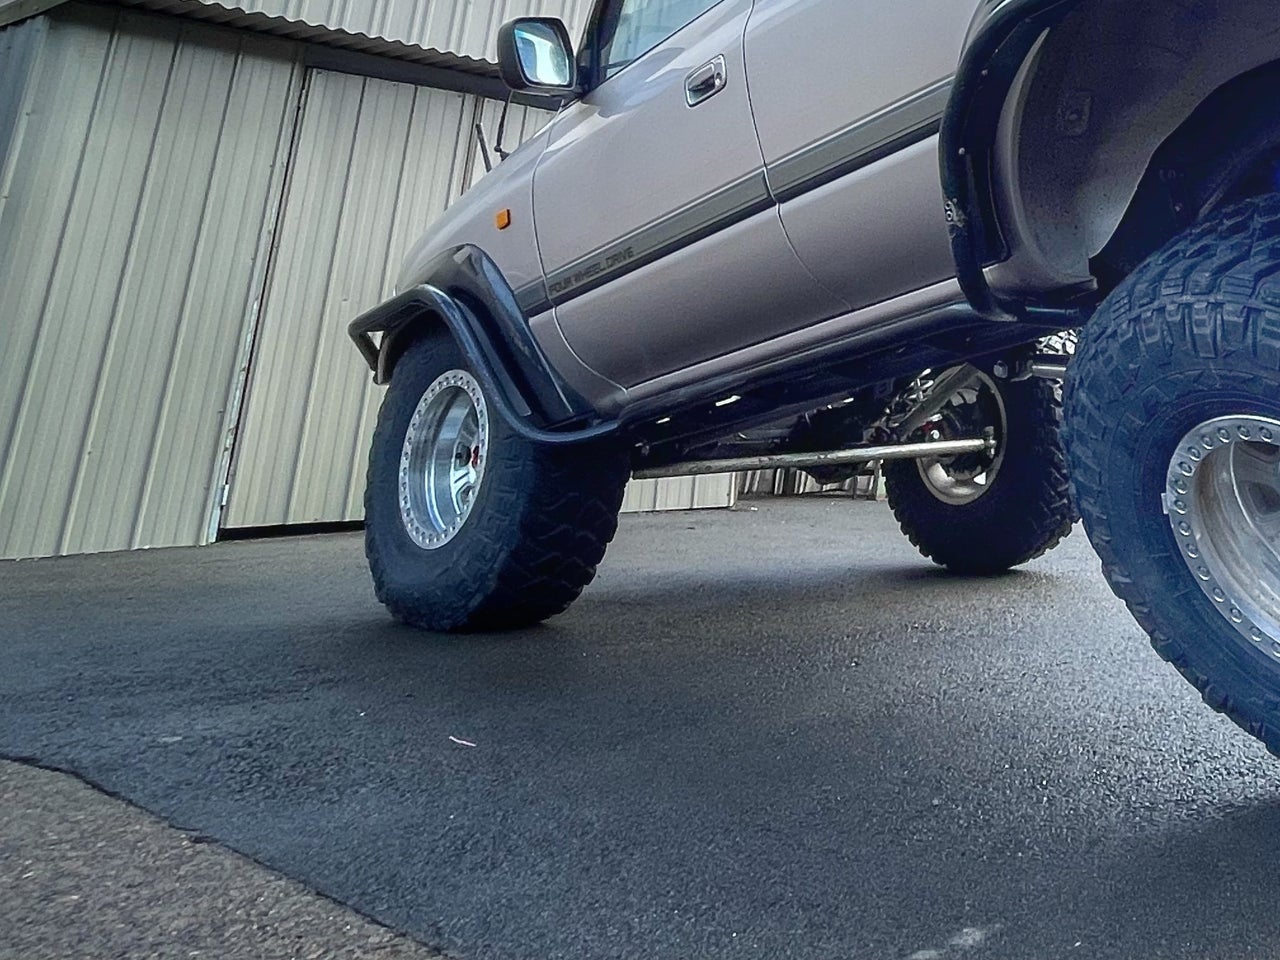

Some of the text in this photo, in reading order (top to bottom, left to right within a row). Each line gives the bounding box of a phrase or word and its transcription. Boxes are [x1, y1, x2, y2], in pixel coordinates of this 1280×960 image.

[548, 246, 635, 296] FOUR WHEEL DRIVE
